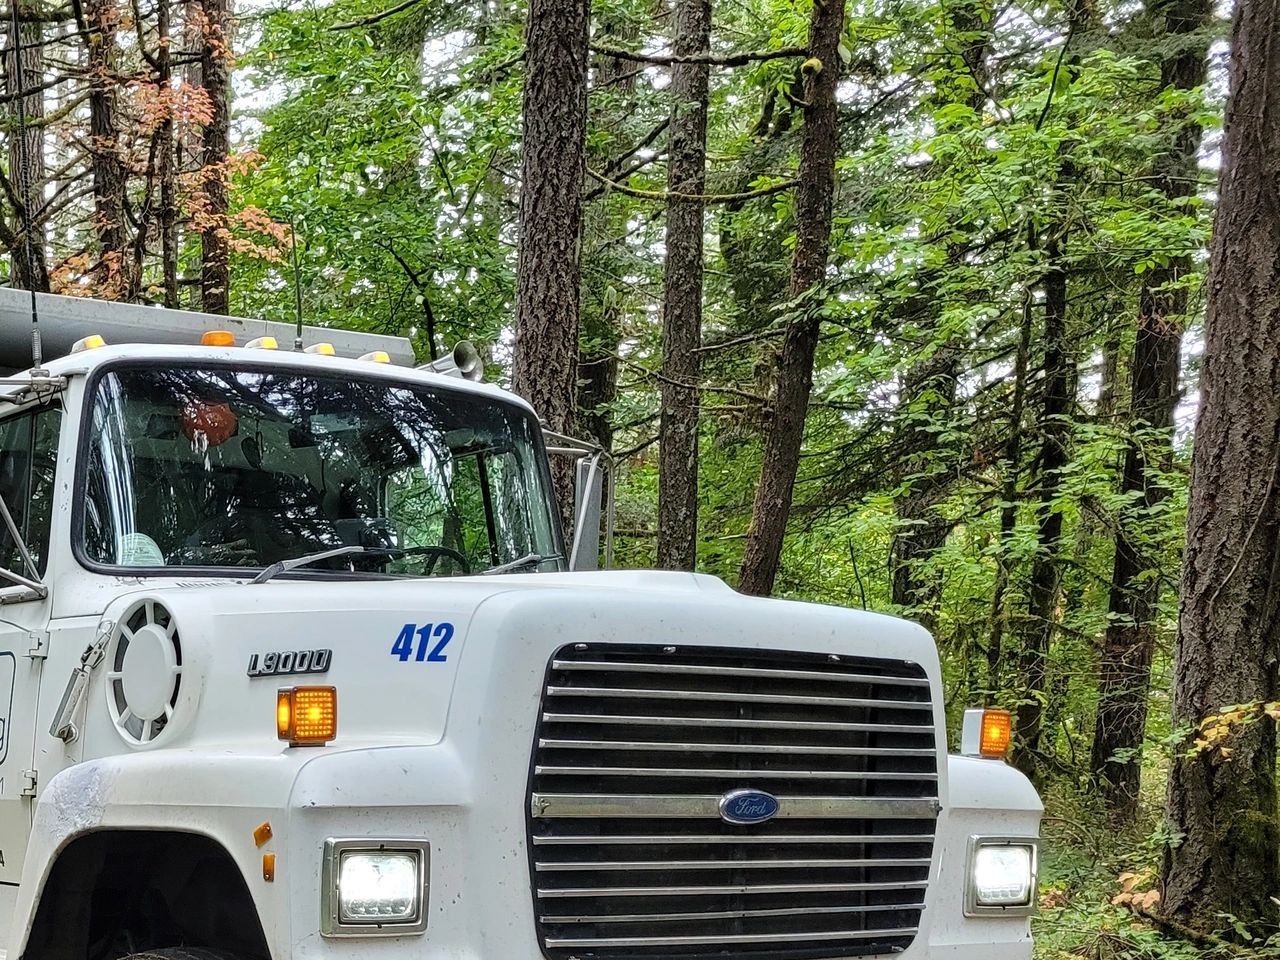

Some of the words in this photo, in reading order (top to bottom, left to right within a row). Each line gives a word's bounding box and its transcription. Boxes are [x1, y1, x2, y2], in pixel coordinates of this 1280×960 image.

[391, 622, 455, 662] 412
[248, 649, 331, 676] L9000
[734, 797, 767, 815] Ford
